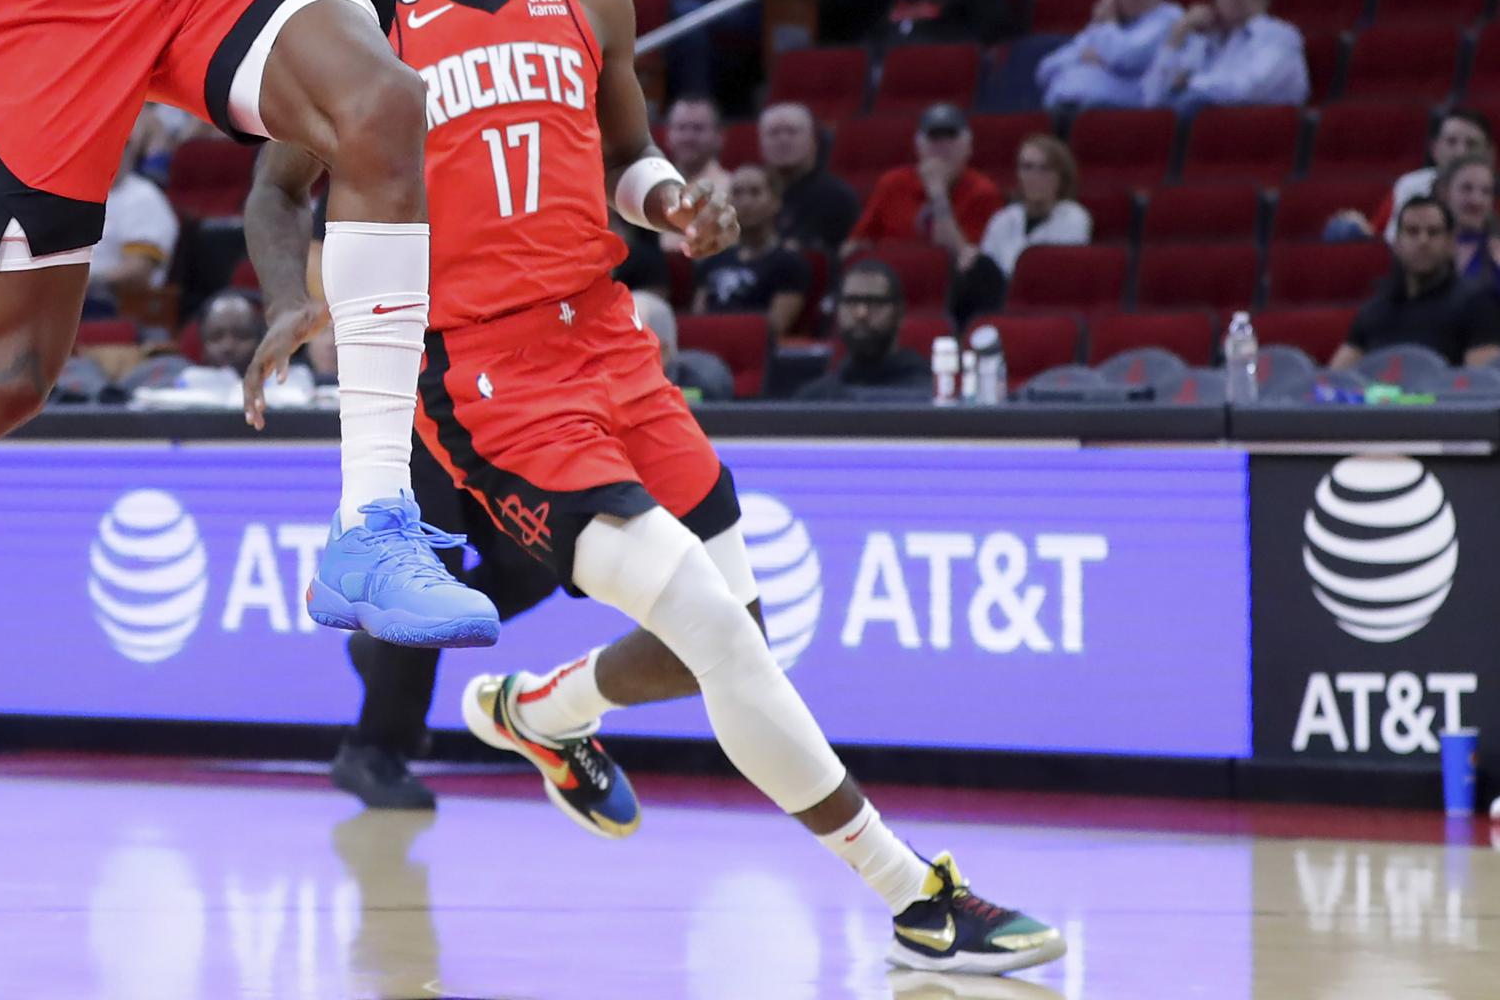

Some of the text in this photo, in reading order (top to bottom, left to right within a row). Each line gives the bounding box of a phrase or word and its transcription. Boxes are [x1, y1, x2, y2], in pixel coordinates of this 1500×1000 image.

[528, 2, 568, 17] karma
[418, 41, 586, 131] ROCKETS
[481, 121, 540, 217] 17
[840, 531, 1109, 653] AT&T
[1292, 671, 1477, 753] AT&T
